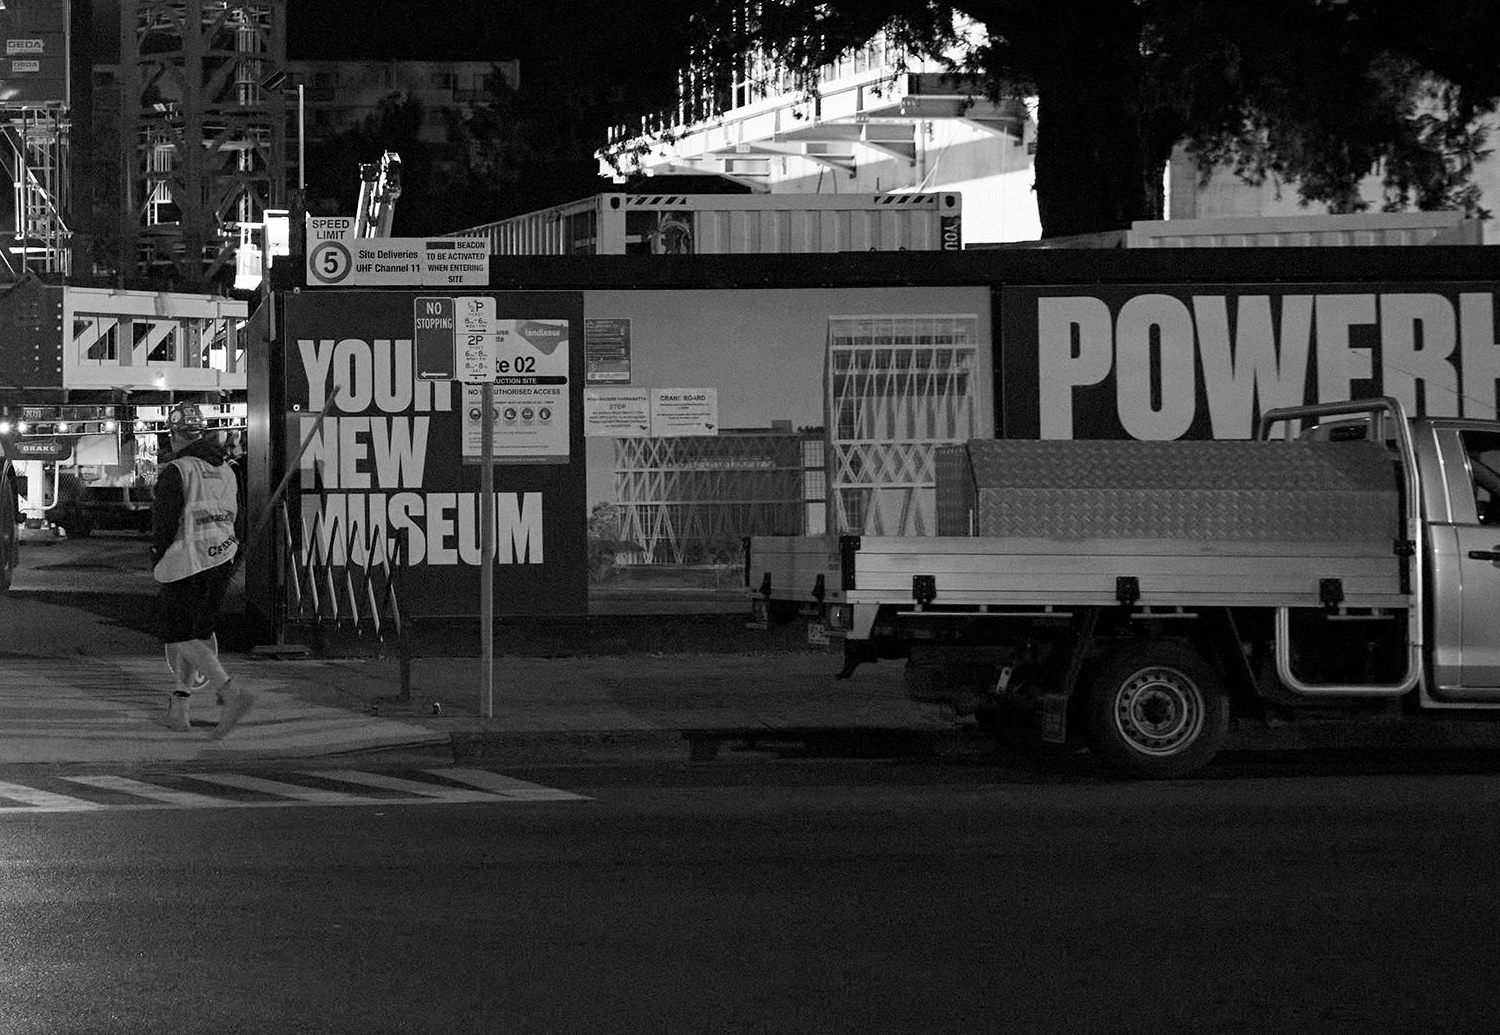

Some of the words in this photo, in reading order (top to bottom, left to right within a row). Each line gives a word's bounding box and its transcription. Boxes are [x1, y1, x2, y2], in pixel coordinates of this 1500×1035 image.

[312, 219, 350, 229] SPEED
[316, 230, 346, 240] LIMIT
[457, 241, 485, 249] BEACON
[359, 249, 375, 259] Site
[377, 249, 418, 259] Deliveries
[323, 251, 338, 274] 5
[356, 264, 373, 272] UHF
[375, 263, 408, 272] Channel
[410, 264, 420, 272] 11
[428, 264, 448, 272] WHEN
[450, 264, 484, 272] ENTERING
[448, 275, 463, 283] SITE
[426, 302, 442, 315] NO
[416, 318, 453, 329] STOPPING
[468, 335, 484, 345] 2P
[514, 356, 536, 373] 02
[300, 417, 430, 489] NEW
[301, 492, 544, 566] MUSEUM
